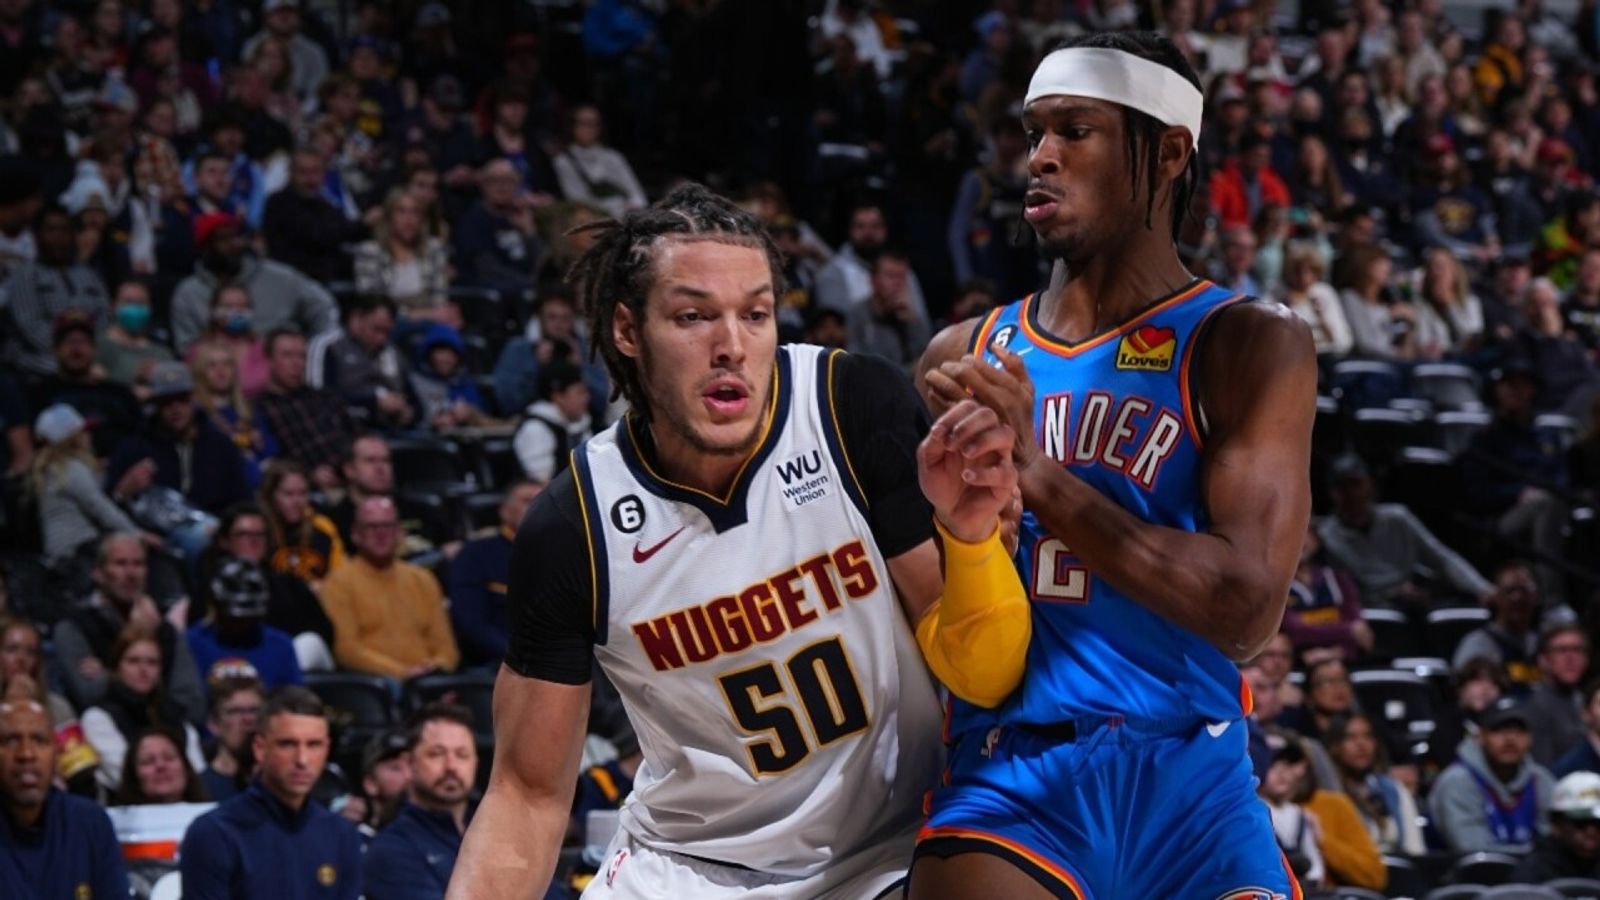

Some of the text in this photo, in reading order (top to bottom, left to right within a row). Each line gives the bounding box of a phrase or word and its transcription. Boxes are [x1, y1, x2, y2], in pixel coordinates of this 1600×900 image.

[1043, 390, 1184, 491] NDER
[776, 450, 821, 485] WU
[783, 475, 828, 498] Western
[794, 488, 826, 506] Union
[618, 500, 641, 530] 6
[631, 539, 879, 673] NUGGETS
[714, 634, 873, 778] 50
